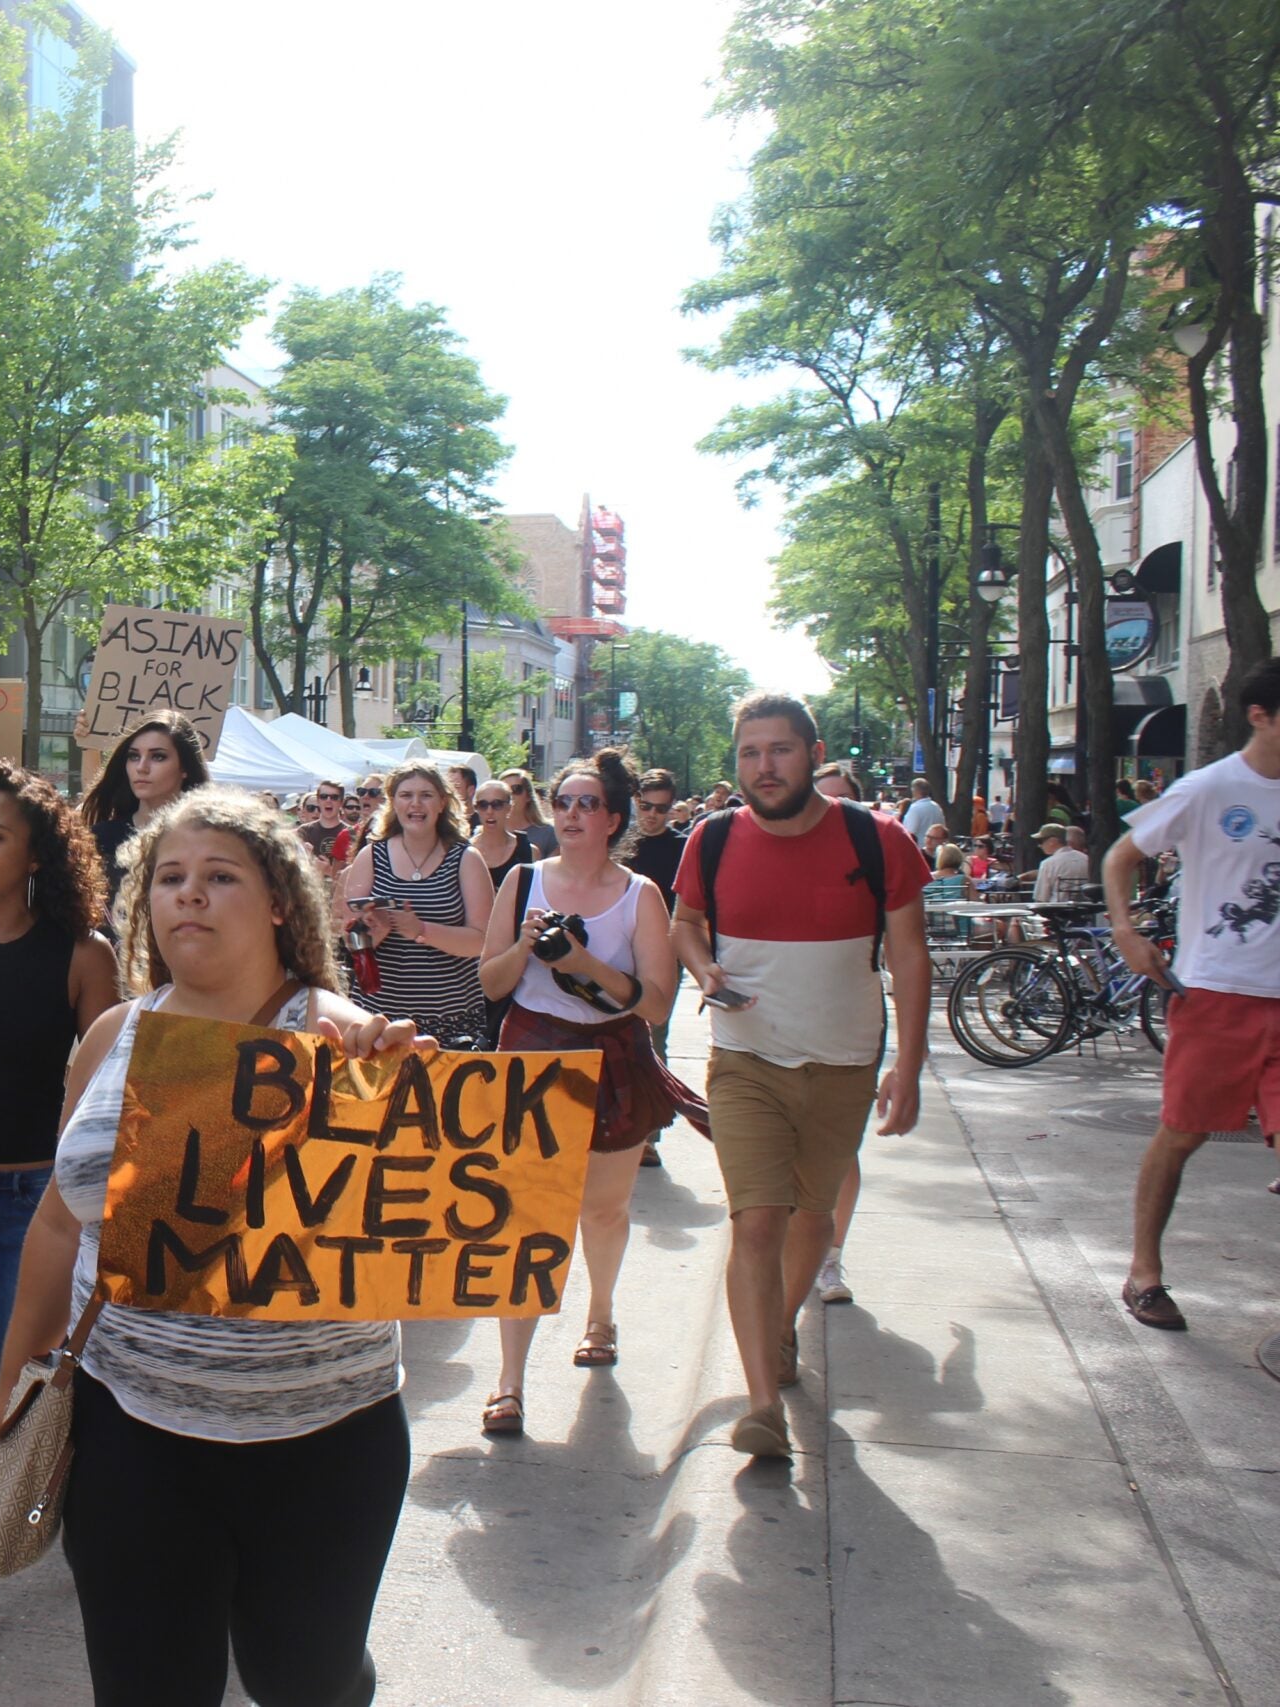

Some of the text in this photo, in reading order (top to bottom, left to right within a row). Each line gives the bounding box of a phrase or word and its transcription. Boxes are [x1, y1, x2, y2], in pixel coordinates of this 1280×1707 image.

[101, 617, 243, 666] ASIANS
[143, 659, 182, 678] FOR
[98, 671, 223, 712] BLACK
[231, 1038, 562, 1160] BLACK
[176, 1126, 514, 1240] LIVES
[146, 1218, 570, 1308] MATTER
